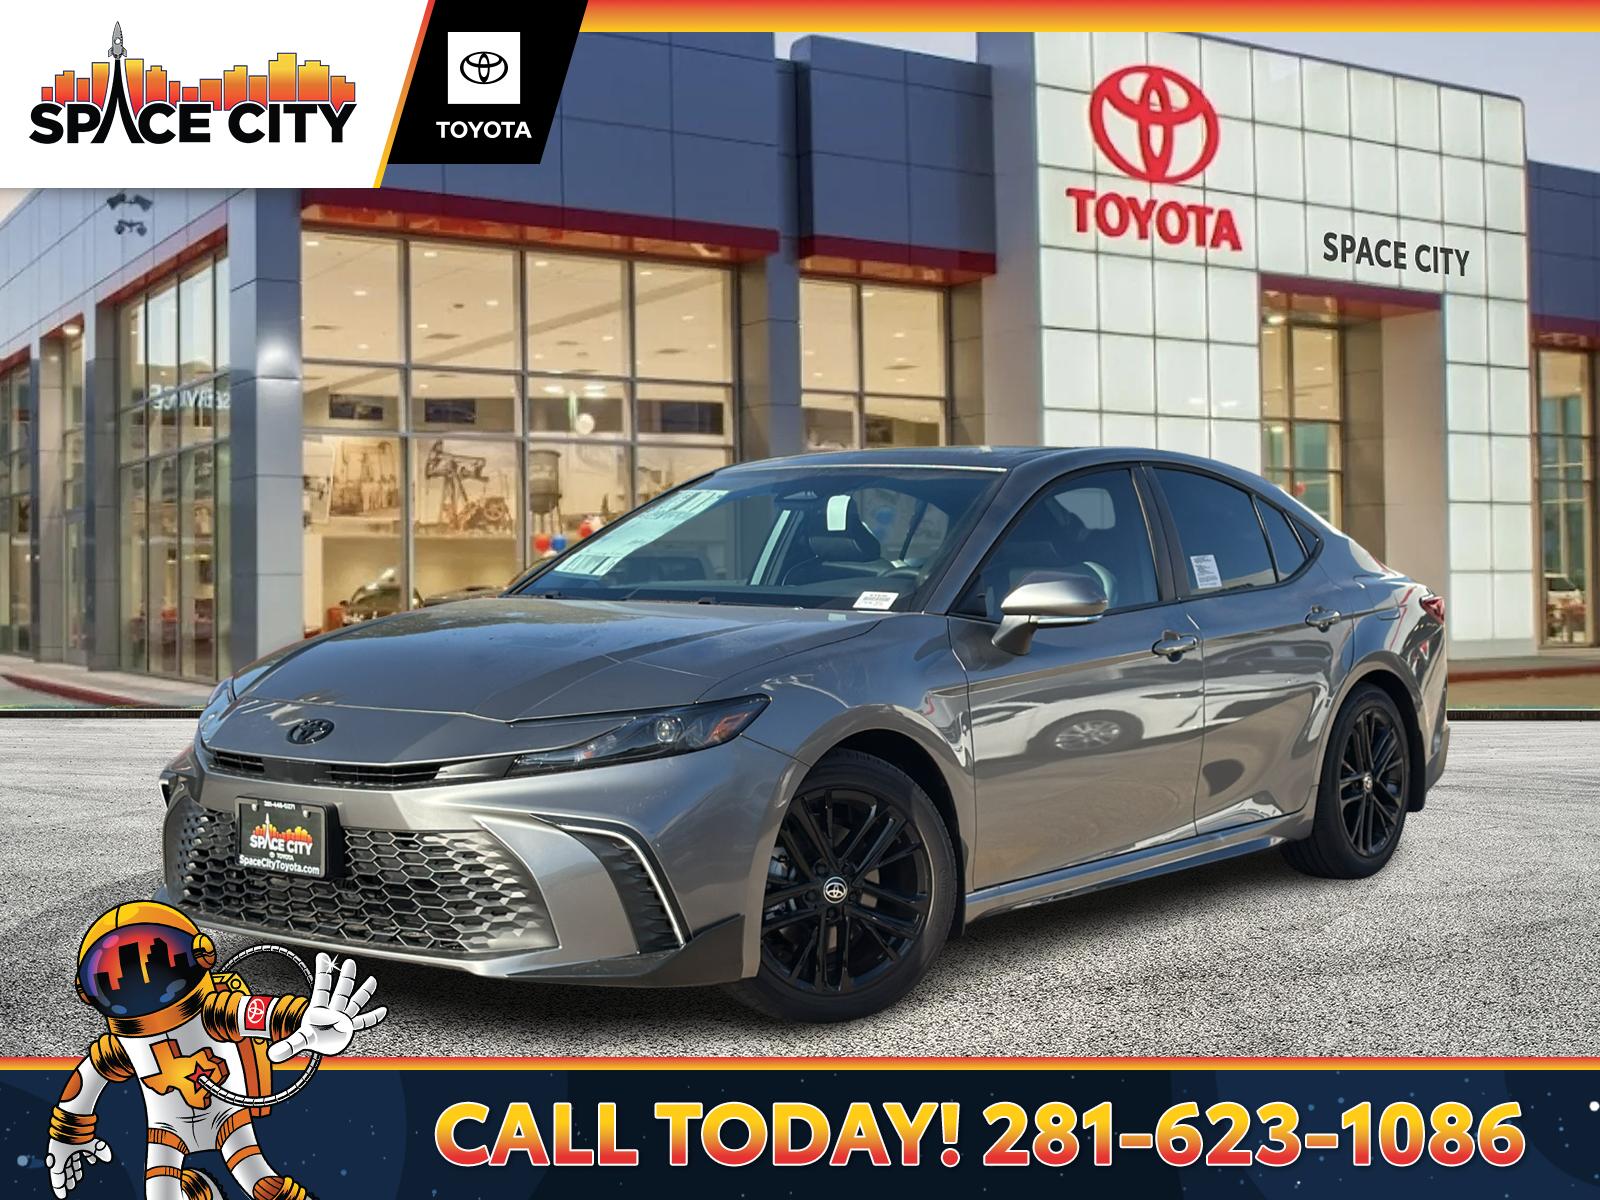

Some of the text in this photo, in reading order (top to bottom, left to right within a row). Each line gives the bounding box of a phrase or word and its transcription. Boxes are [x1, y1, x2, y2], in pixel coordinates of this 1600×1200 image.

[1066, 187, 1243, 252] TOYOTA
[1323, 231, 1471, 277] SPACE CITY
[249, 826, 313, 856] SPACE CITY
[239, 854, 320, 875] SpaceCityToyota.com
